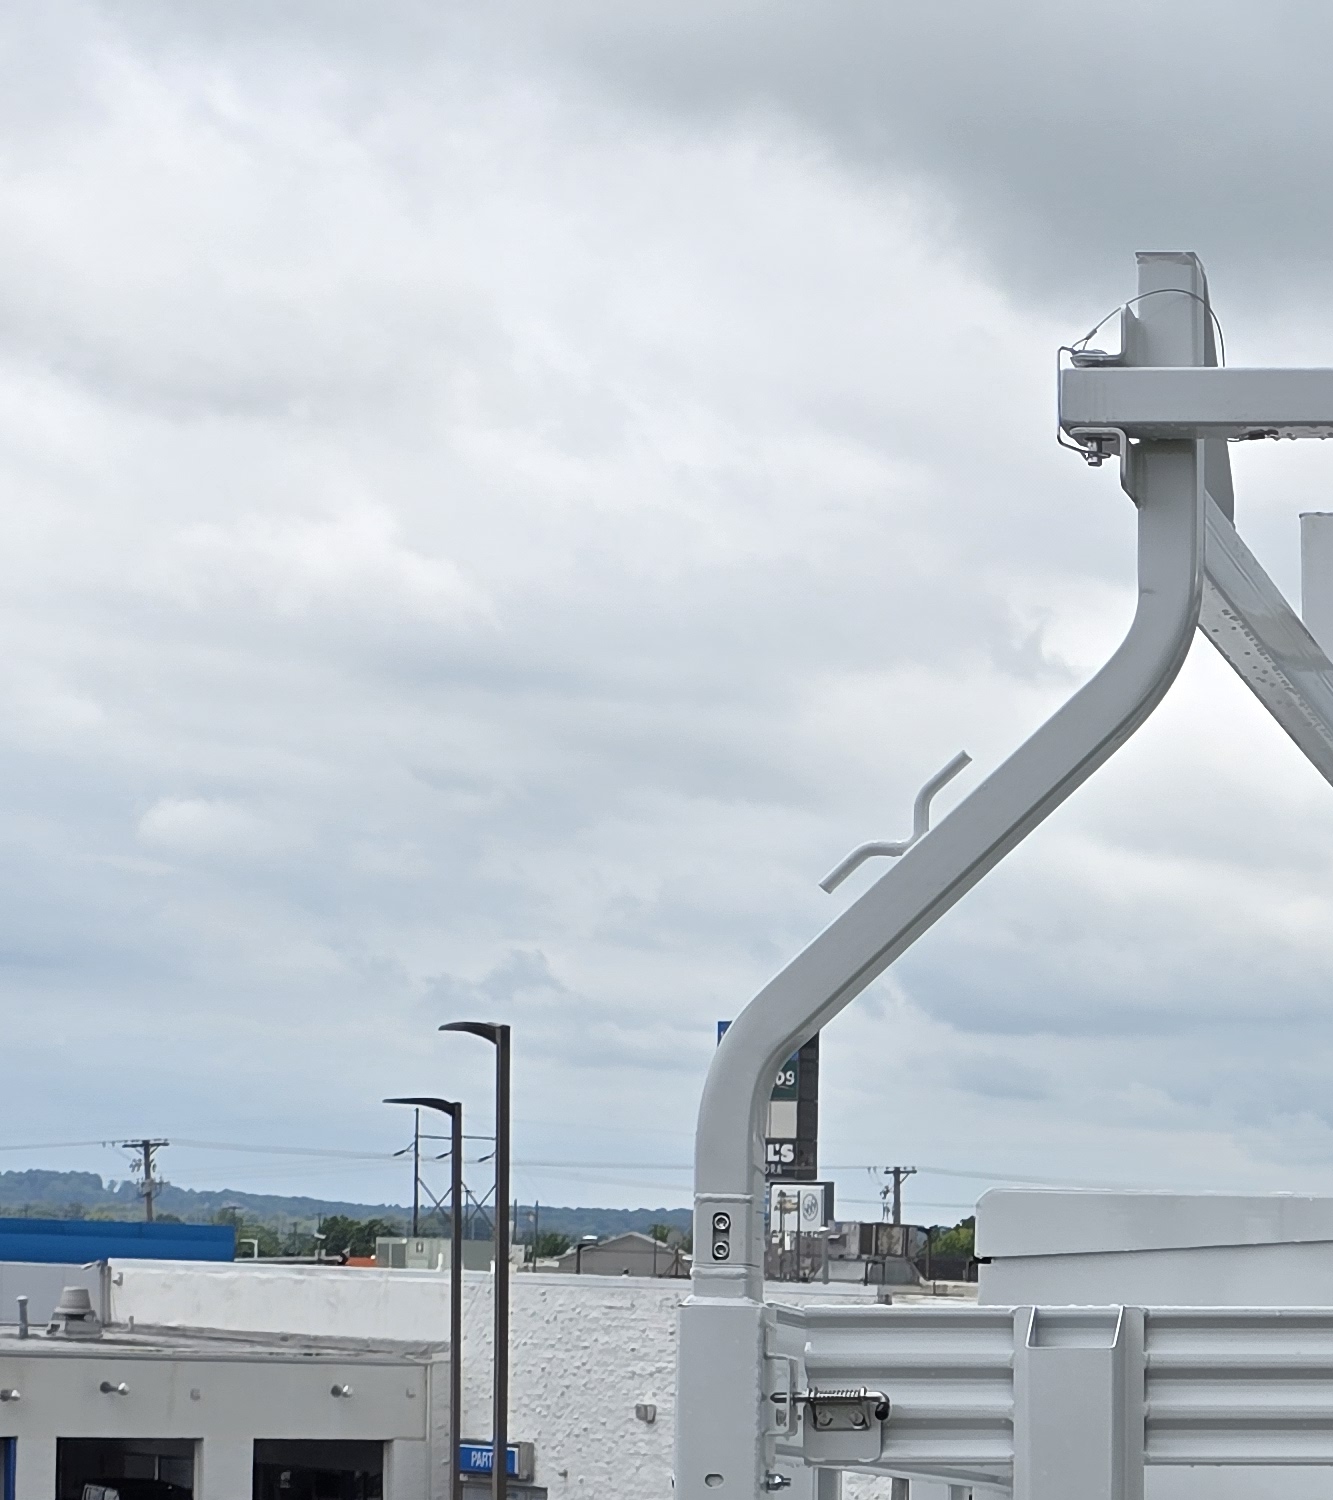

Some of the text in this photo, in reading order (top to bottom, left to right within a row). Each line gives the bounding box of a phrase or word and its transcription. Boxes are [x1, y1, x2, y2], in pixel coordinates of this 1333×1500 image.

[767, 1144, 795, 1163] L'S
[764, 1164, 783, 1175] ORA
[471, 1451, 494, 1468] PART
